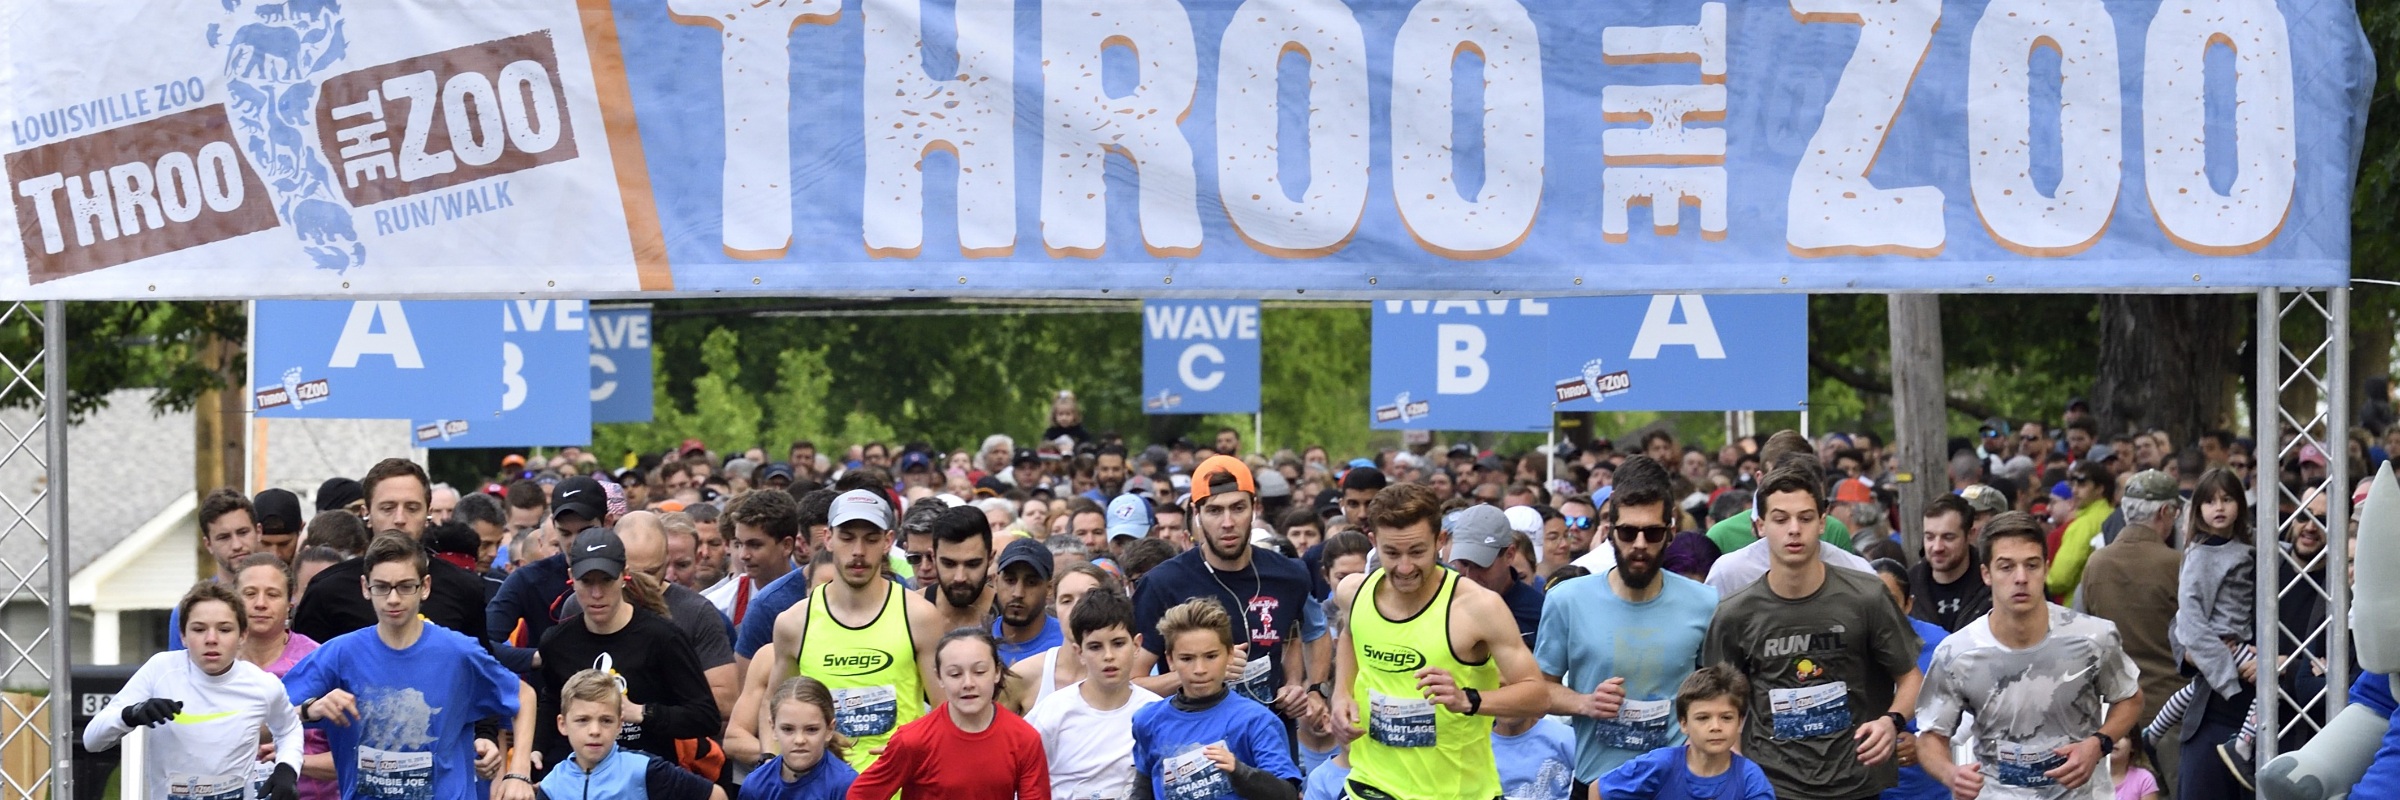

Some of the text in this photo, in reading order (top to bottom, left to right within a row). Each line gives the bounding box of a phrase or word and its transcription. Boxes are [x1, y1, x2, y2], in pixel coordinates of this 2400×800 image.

[11, 76, 205, 146] LOUISVILLE ZOO
[666, 0, 2296, 259] THROO THE ZOO
[18, 59, 561, 254] THROO THE ZOO
[374, 180, 514, 236] RUN/WALK
[328, 300, 425, 369] A
[1145, 304, 1257, 340] WAVE
[1628, 294, 1727, 359] A
[1178, 342, 1226, 392] C
[1437, 324, 1490, 395] B
[823, 654, 882, 668] Swags
[1363, 644, 1416, 666] Swags
[843, 713, 878, 724] JACOB
[1387, 733, 1406, 742] 644
[365, 774, 402, 787] BOBBIE
[403, 778, 425, 787] JOE
[1176, 772, 1222, 794] CHARLIE
